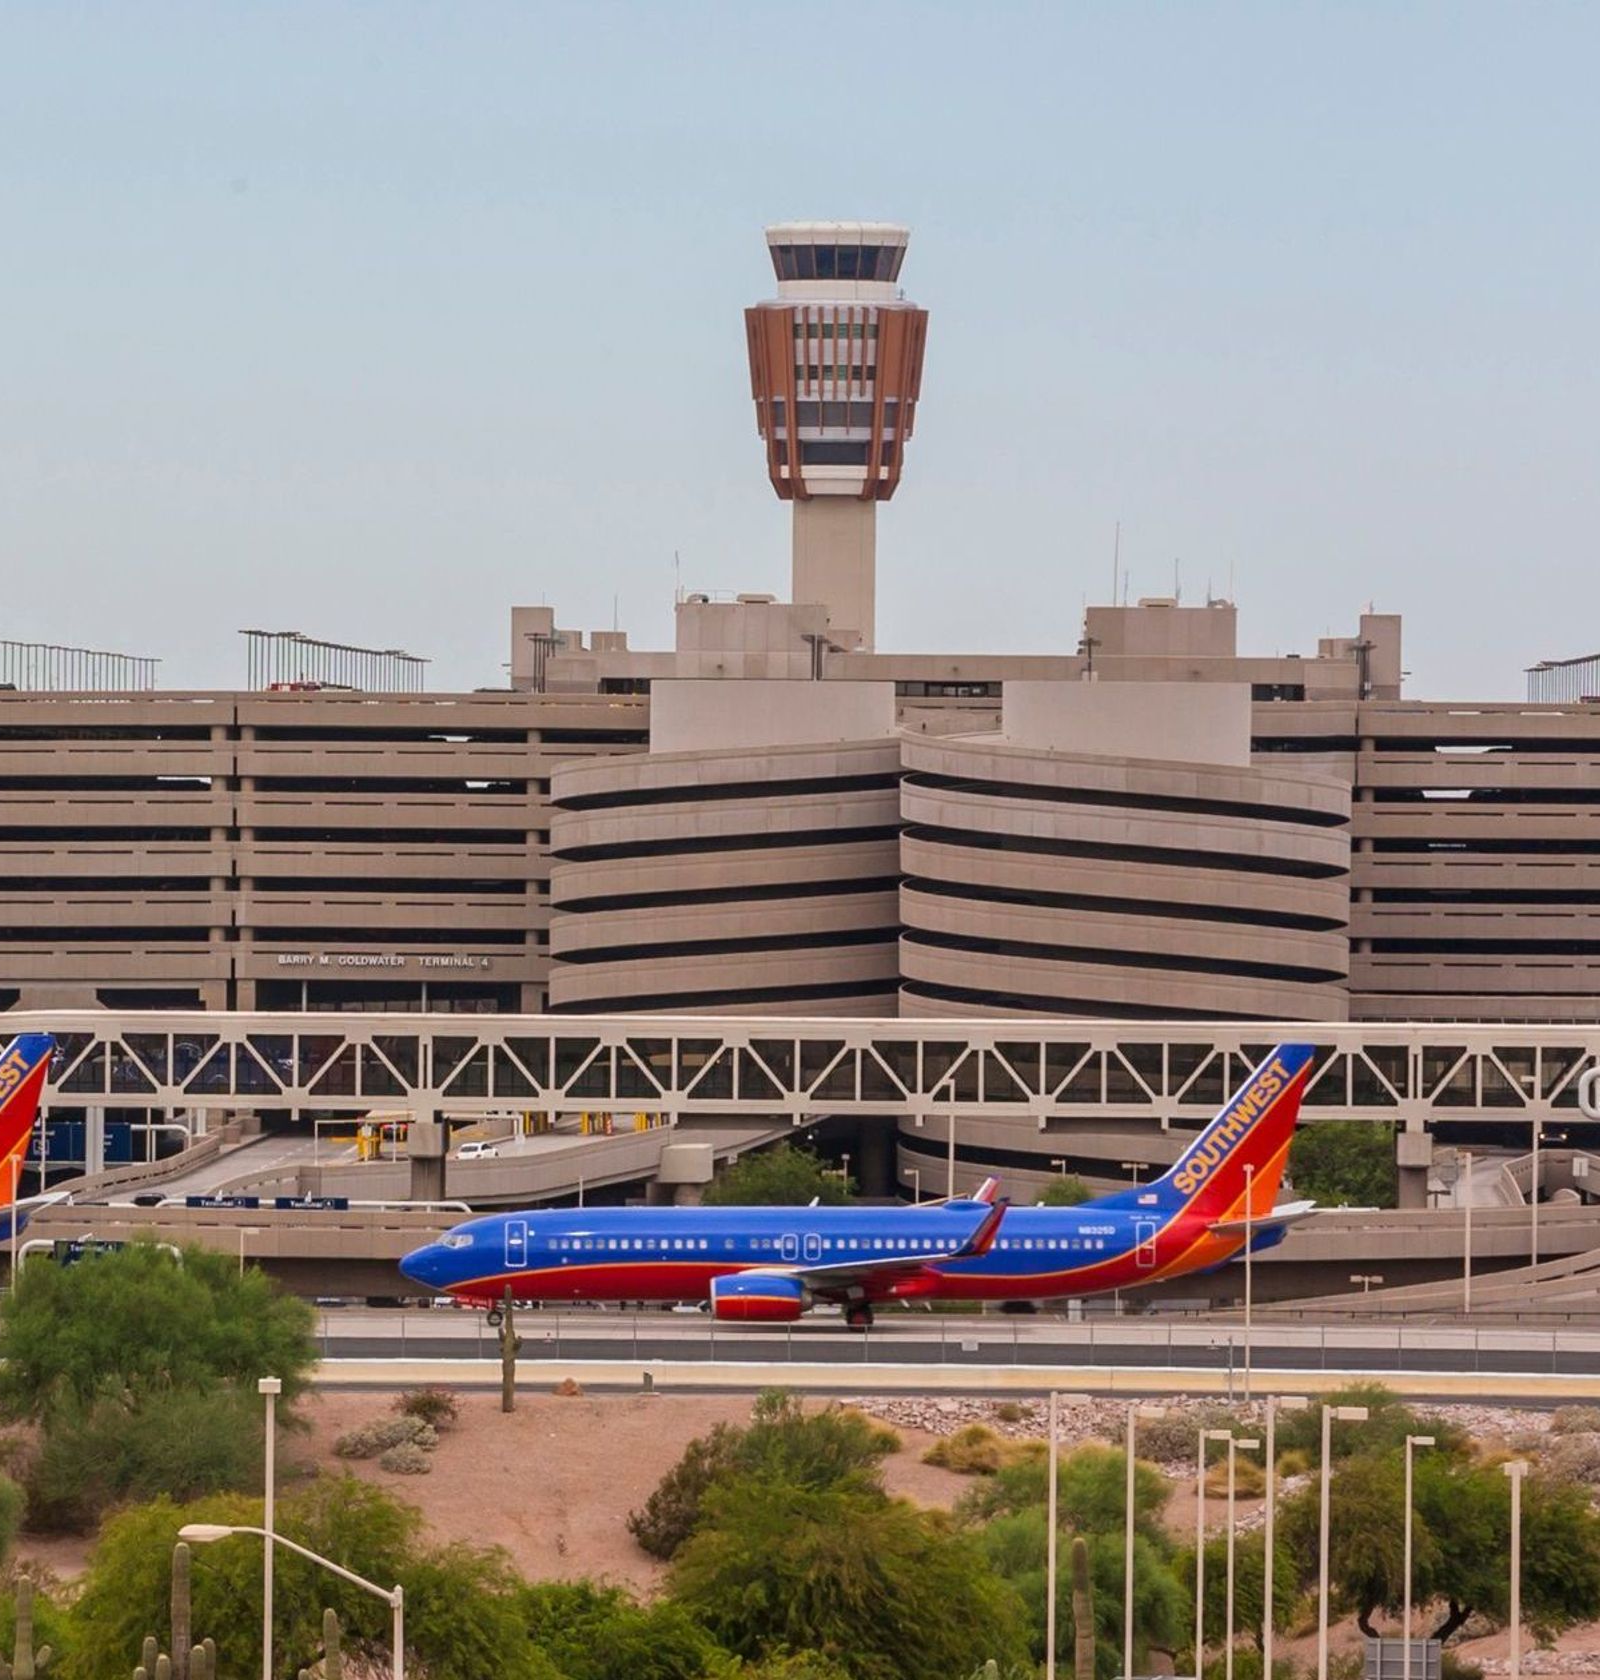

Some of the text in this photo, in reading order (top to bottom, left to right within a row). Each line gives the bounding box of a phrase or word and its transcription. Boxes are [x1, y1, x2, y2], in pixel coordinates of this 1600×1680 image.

[278, 954, 314, 965] BARRY
[338, 955, 406, 966] GOLDWATER
[418, 956, 475, 967] TERMINAL
[481, 957, 489, 967] 4
[1172, 1057, 1290, 1195] SOUTHWEST
